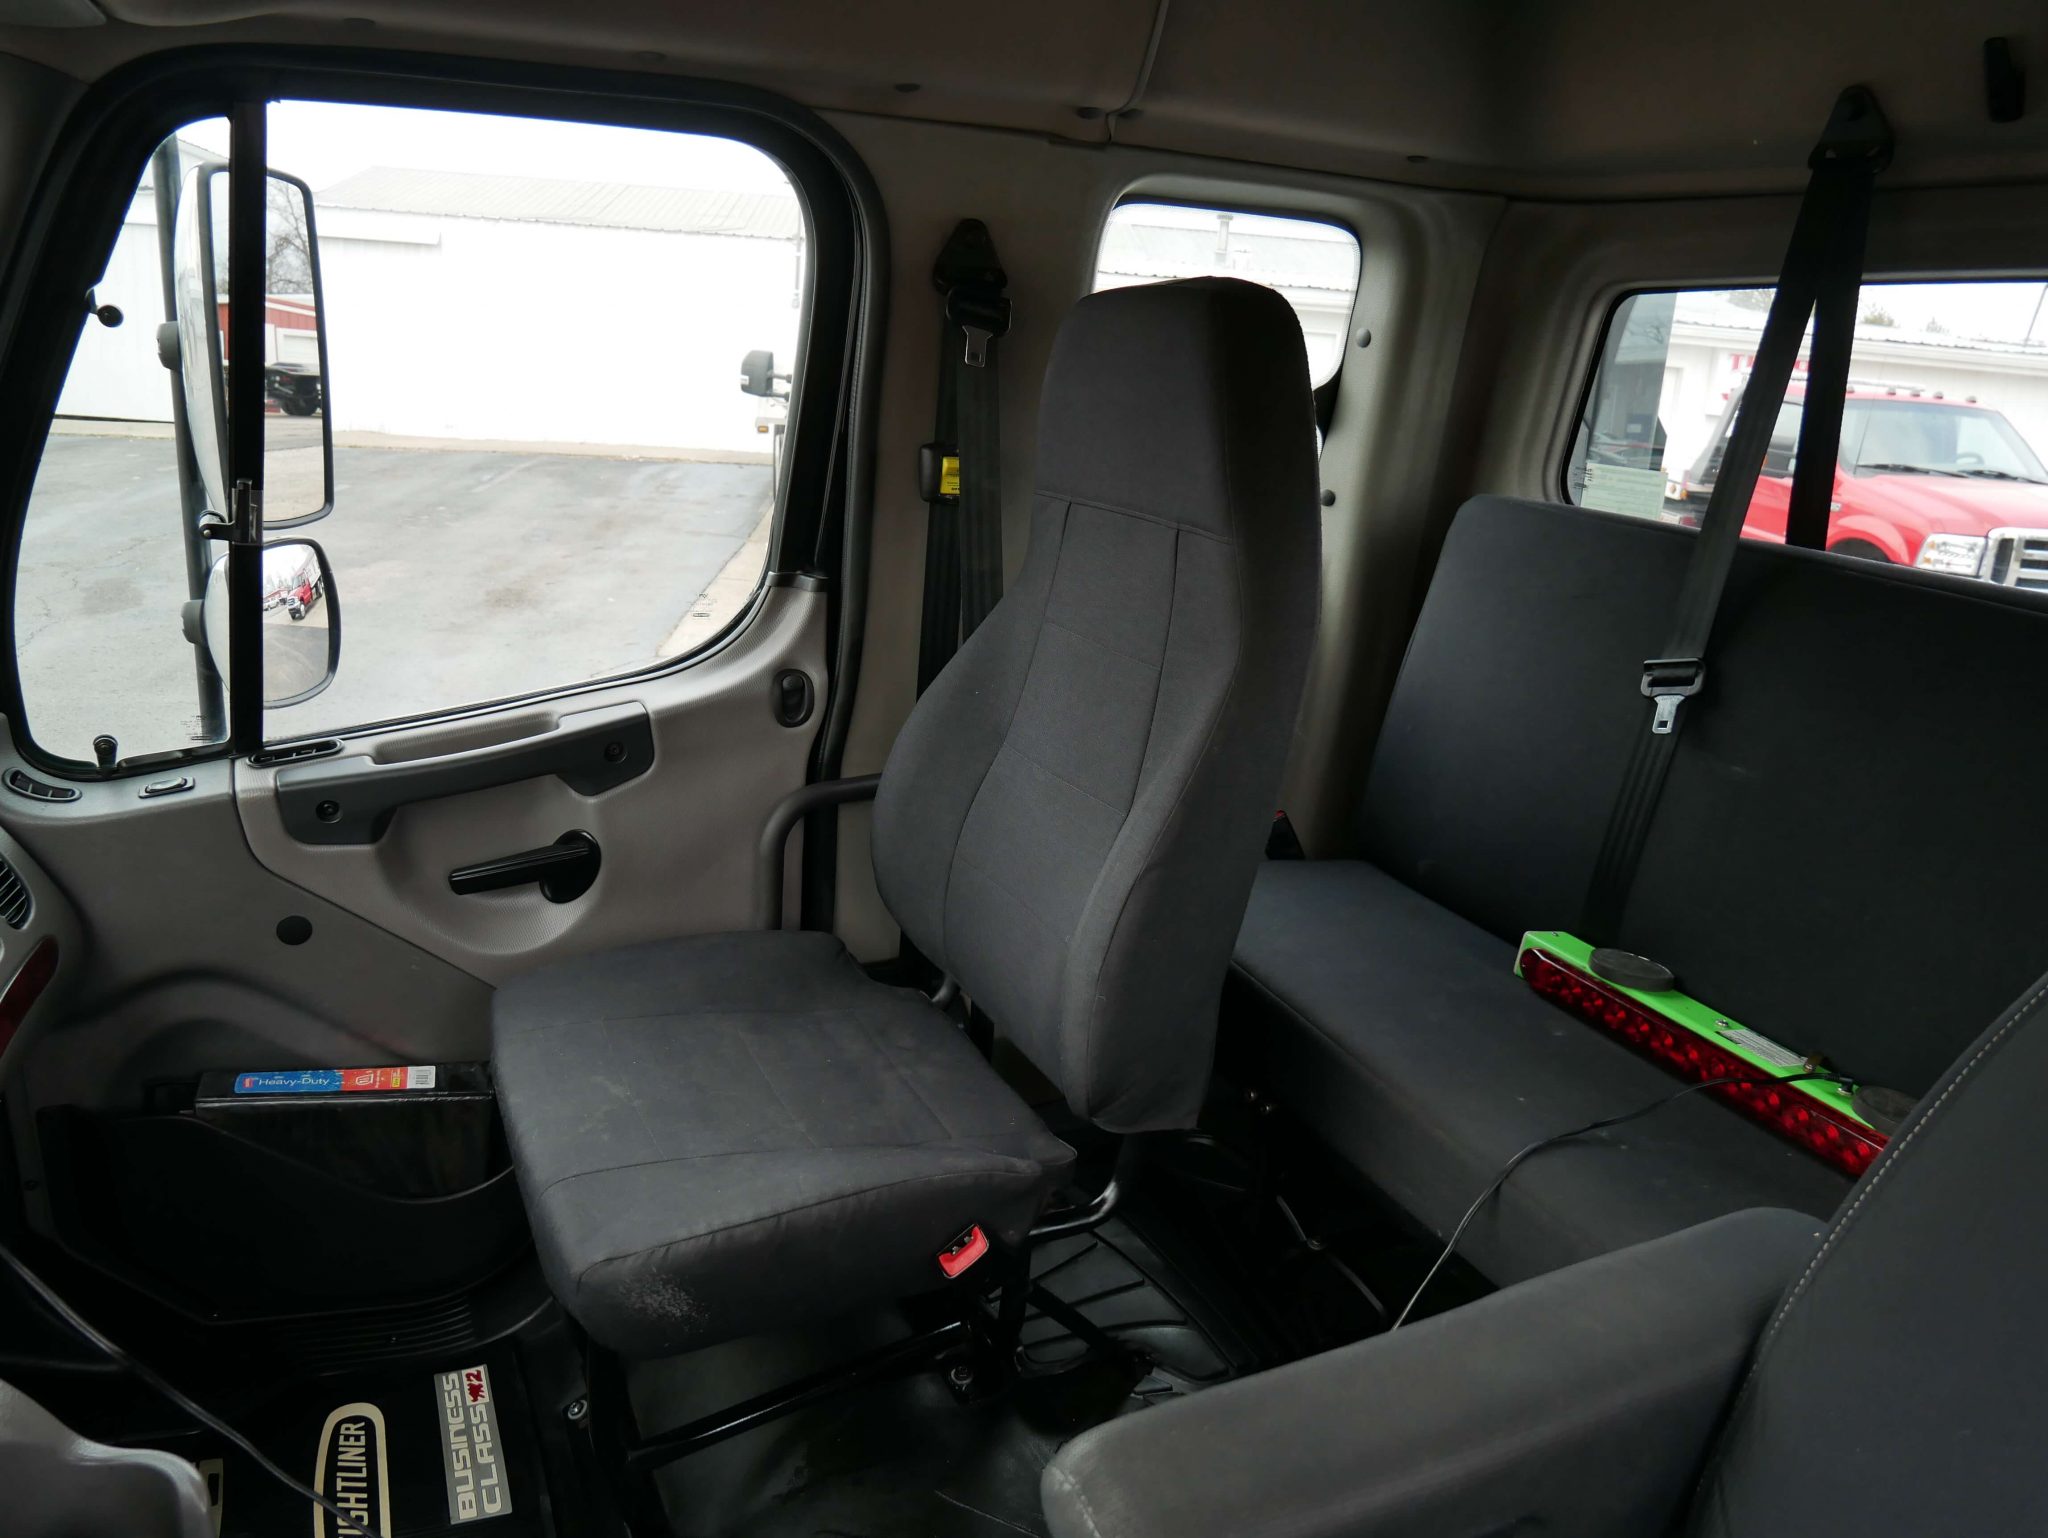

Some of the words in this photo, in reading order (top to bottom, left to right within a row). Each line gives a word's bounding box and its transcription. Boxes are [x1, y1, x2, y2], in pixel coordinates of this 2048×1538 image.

[258, 1077, 330, 1086] Heavy-Duty
[336, 1422, 369, 1538] IGHTLINER
[442, 1372, 478, 1520] BUSINESS
[469, 1404, 502, 1514] CLASS
